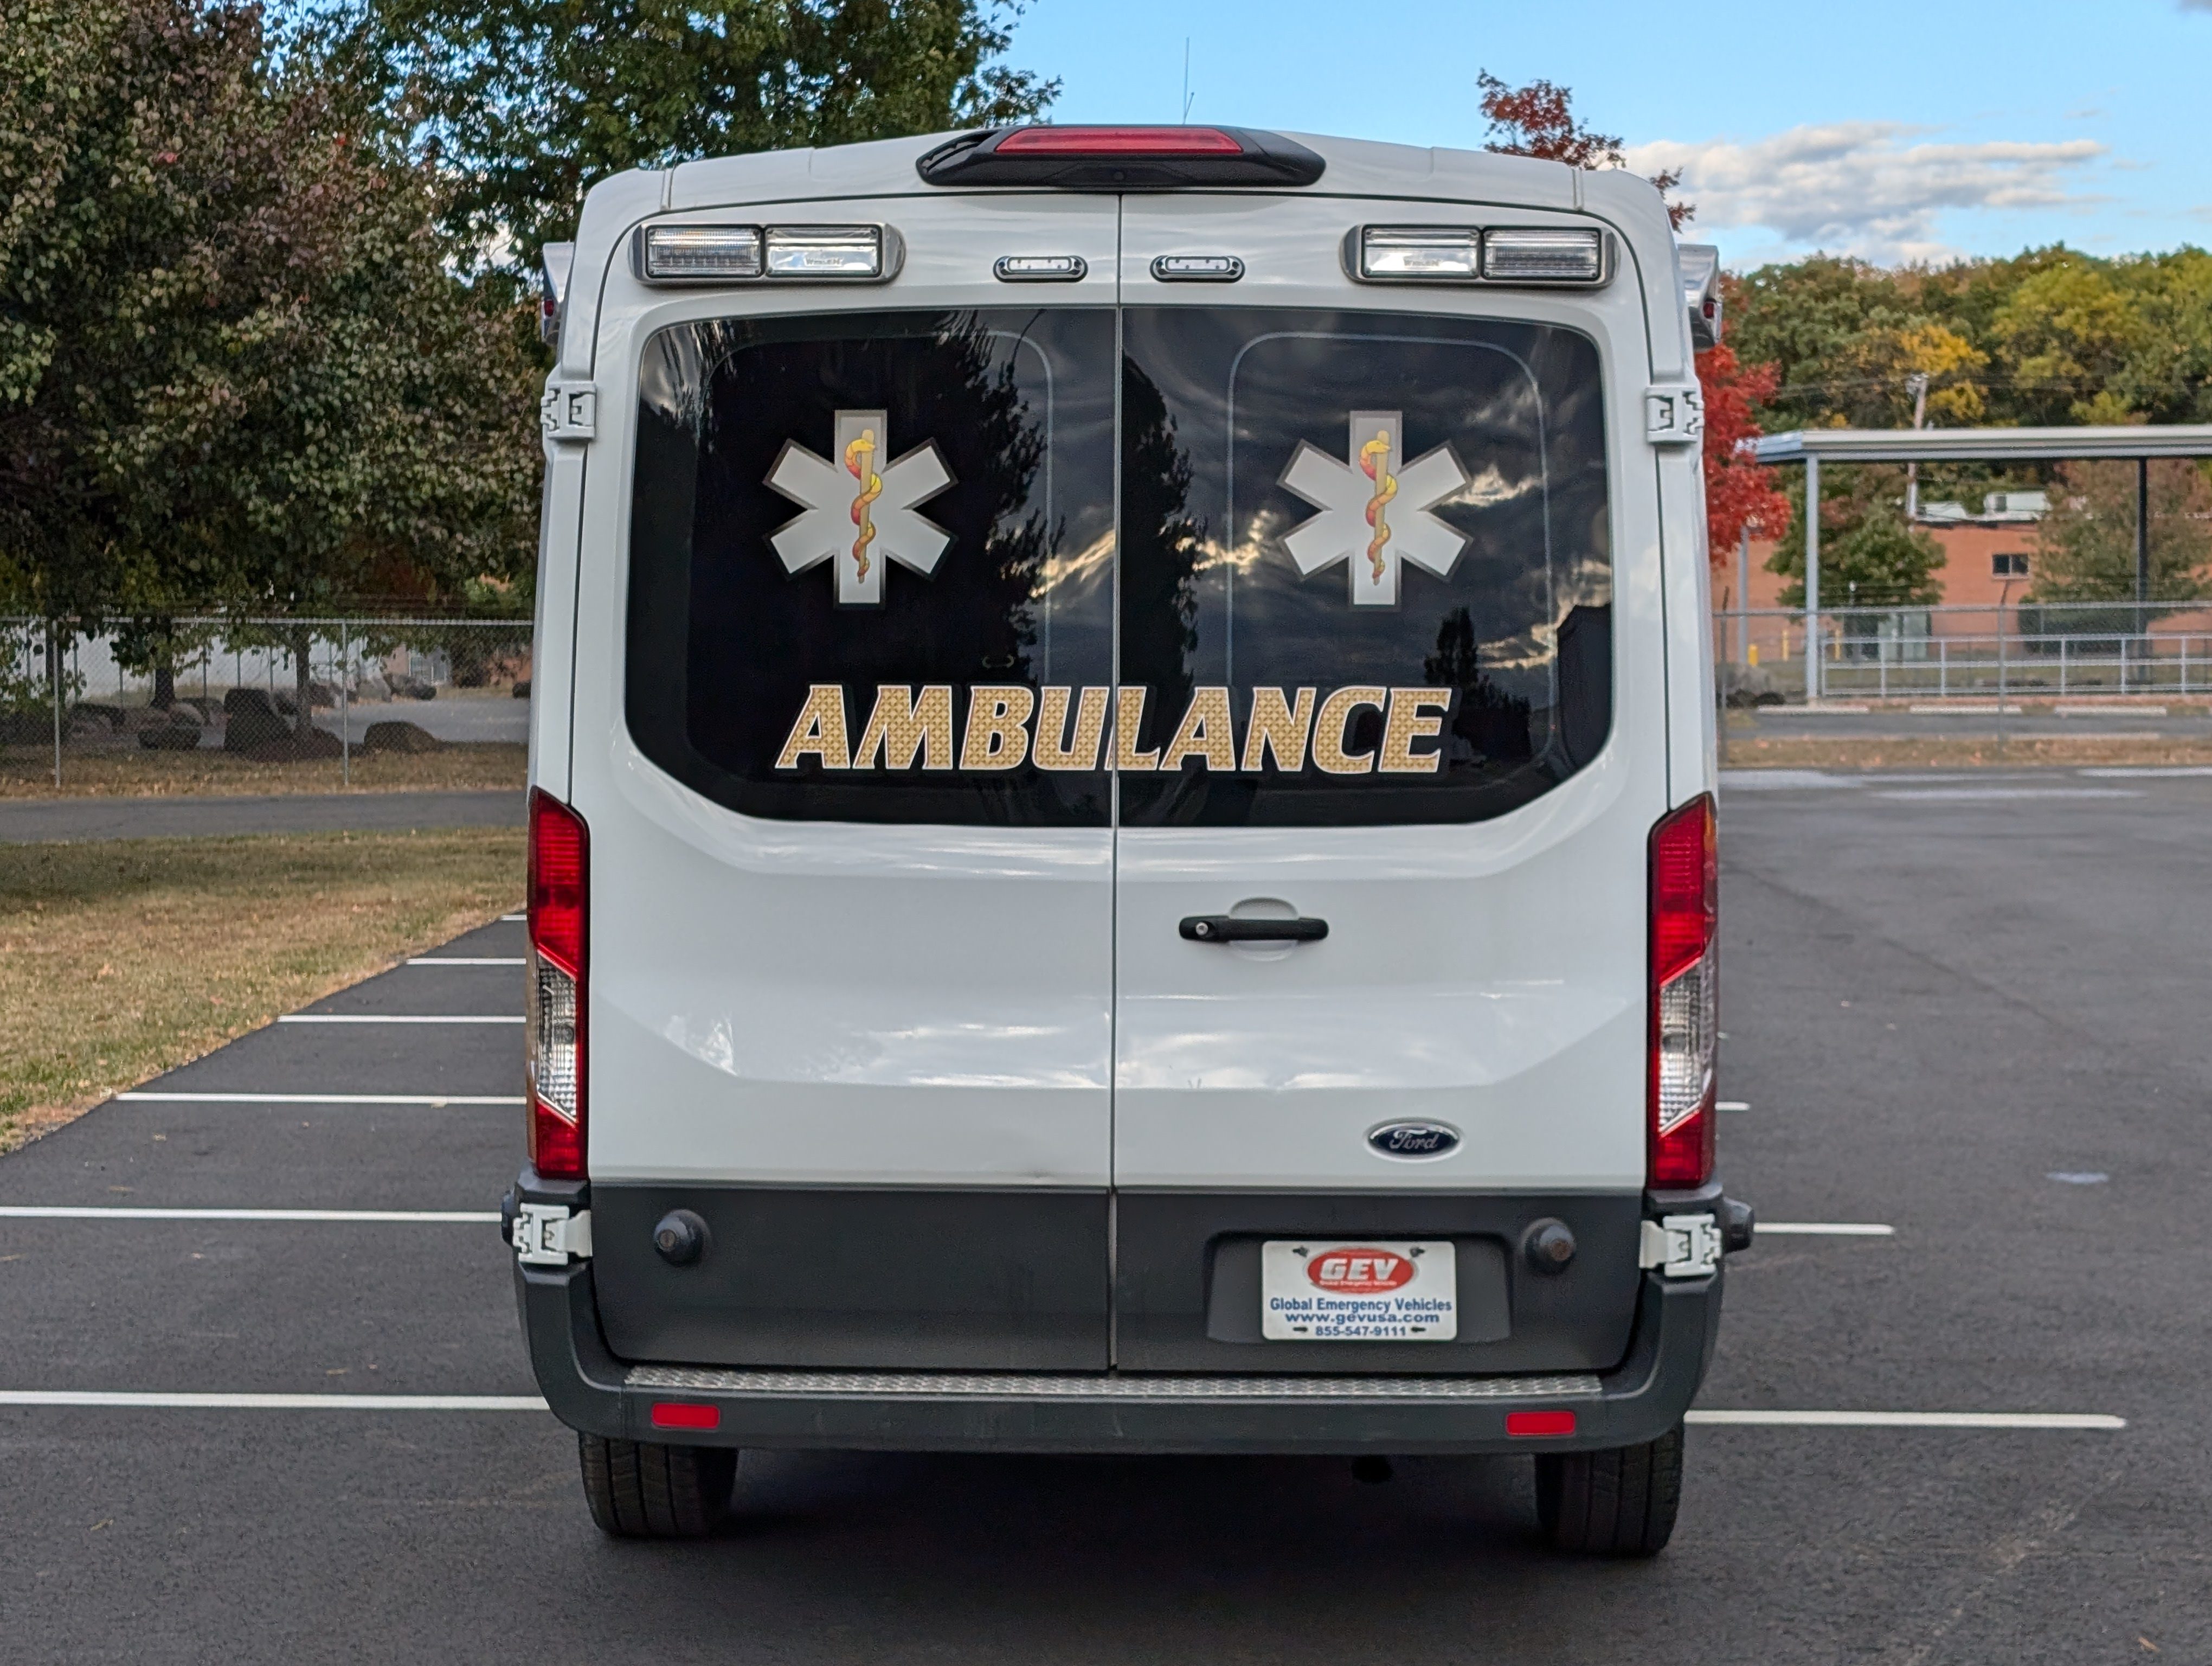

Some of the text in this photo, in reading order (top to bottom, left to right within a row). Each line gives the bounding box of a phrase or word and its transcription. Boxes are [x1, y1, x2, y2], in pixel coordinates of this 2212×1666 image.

[775, 684, 1452, 774] AMBULANCE
[1389, 1130, 1439, 1149] Ford
[1320, 1258, 1398, 1280] GEV
[1270, 1297, 1452, 1313] Global Emergency Vehicles
[1285, 1313, 1440, 1324] www.gevusa.com
[1315, 1326, 1406, 1336] 855-547-9111
